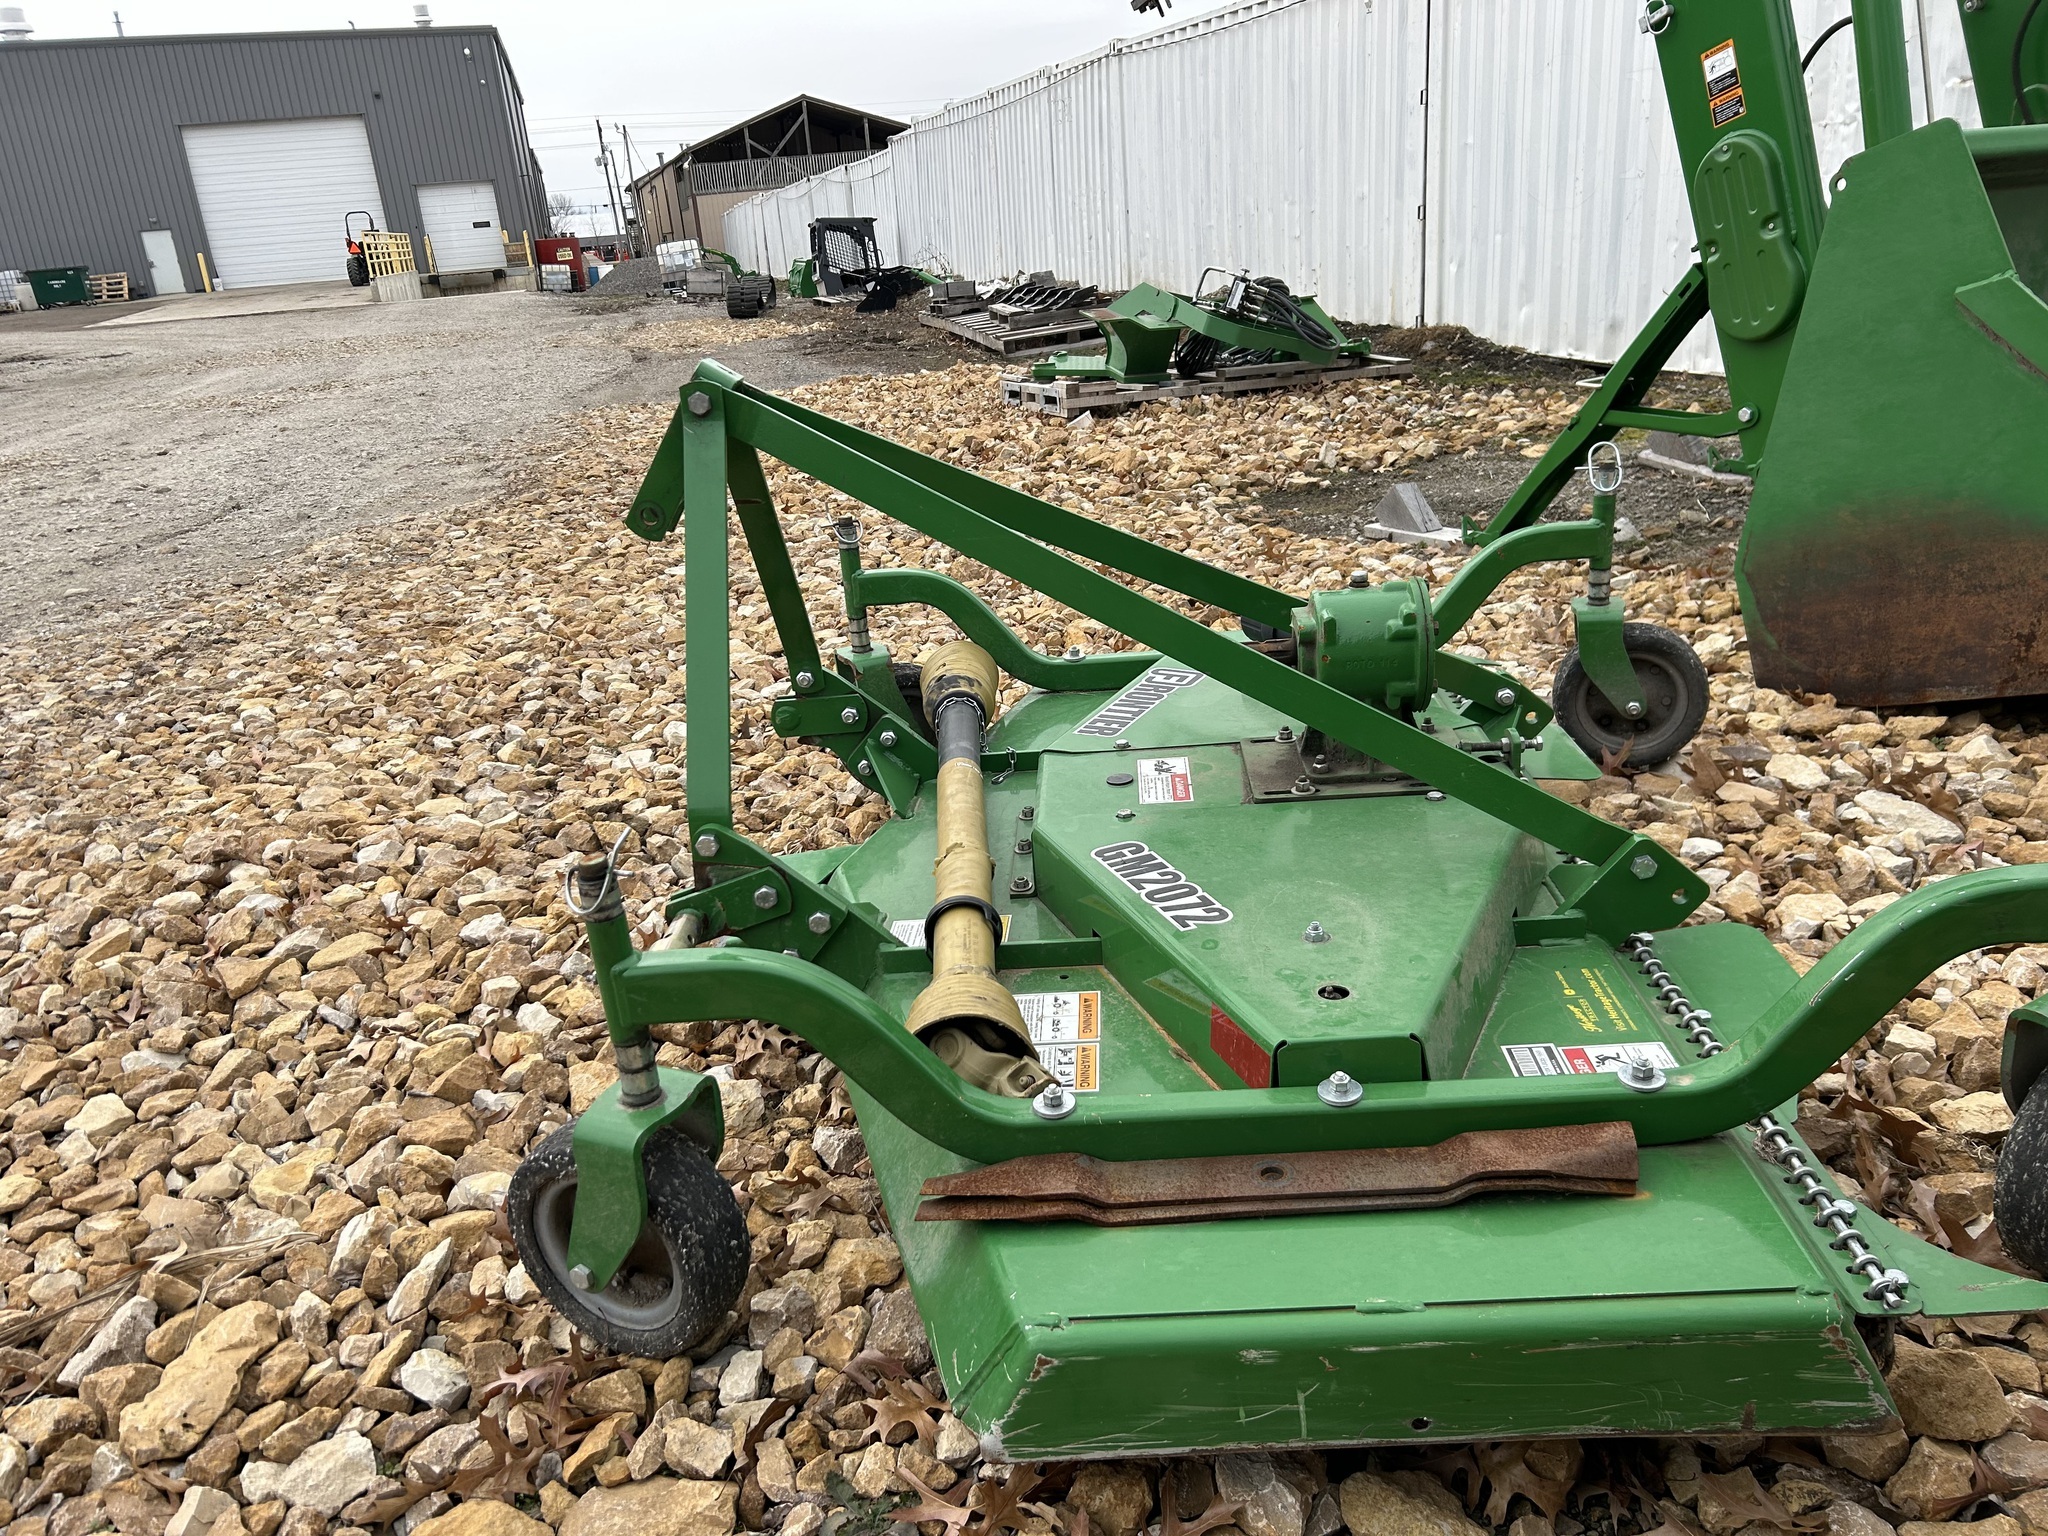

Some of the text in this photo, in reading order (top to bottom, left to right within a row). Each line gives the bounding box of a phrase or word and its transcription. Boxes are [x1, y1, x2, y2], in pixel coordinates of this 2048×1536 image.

[1709, 42, 1730, 55] WARNING
[1074, 667, 1206, 737] FRONTIER
[1092, 842, 1232, 930] GM2072
[1082, 1003, 1094, 1034] WARNING
[1079, 1051, 1091, 1088] WARNING
